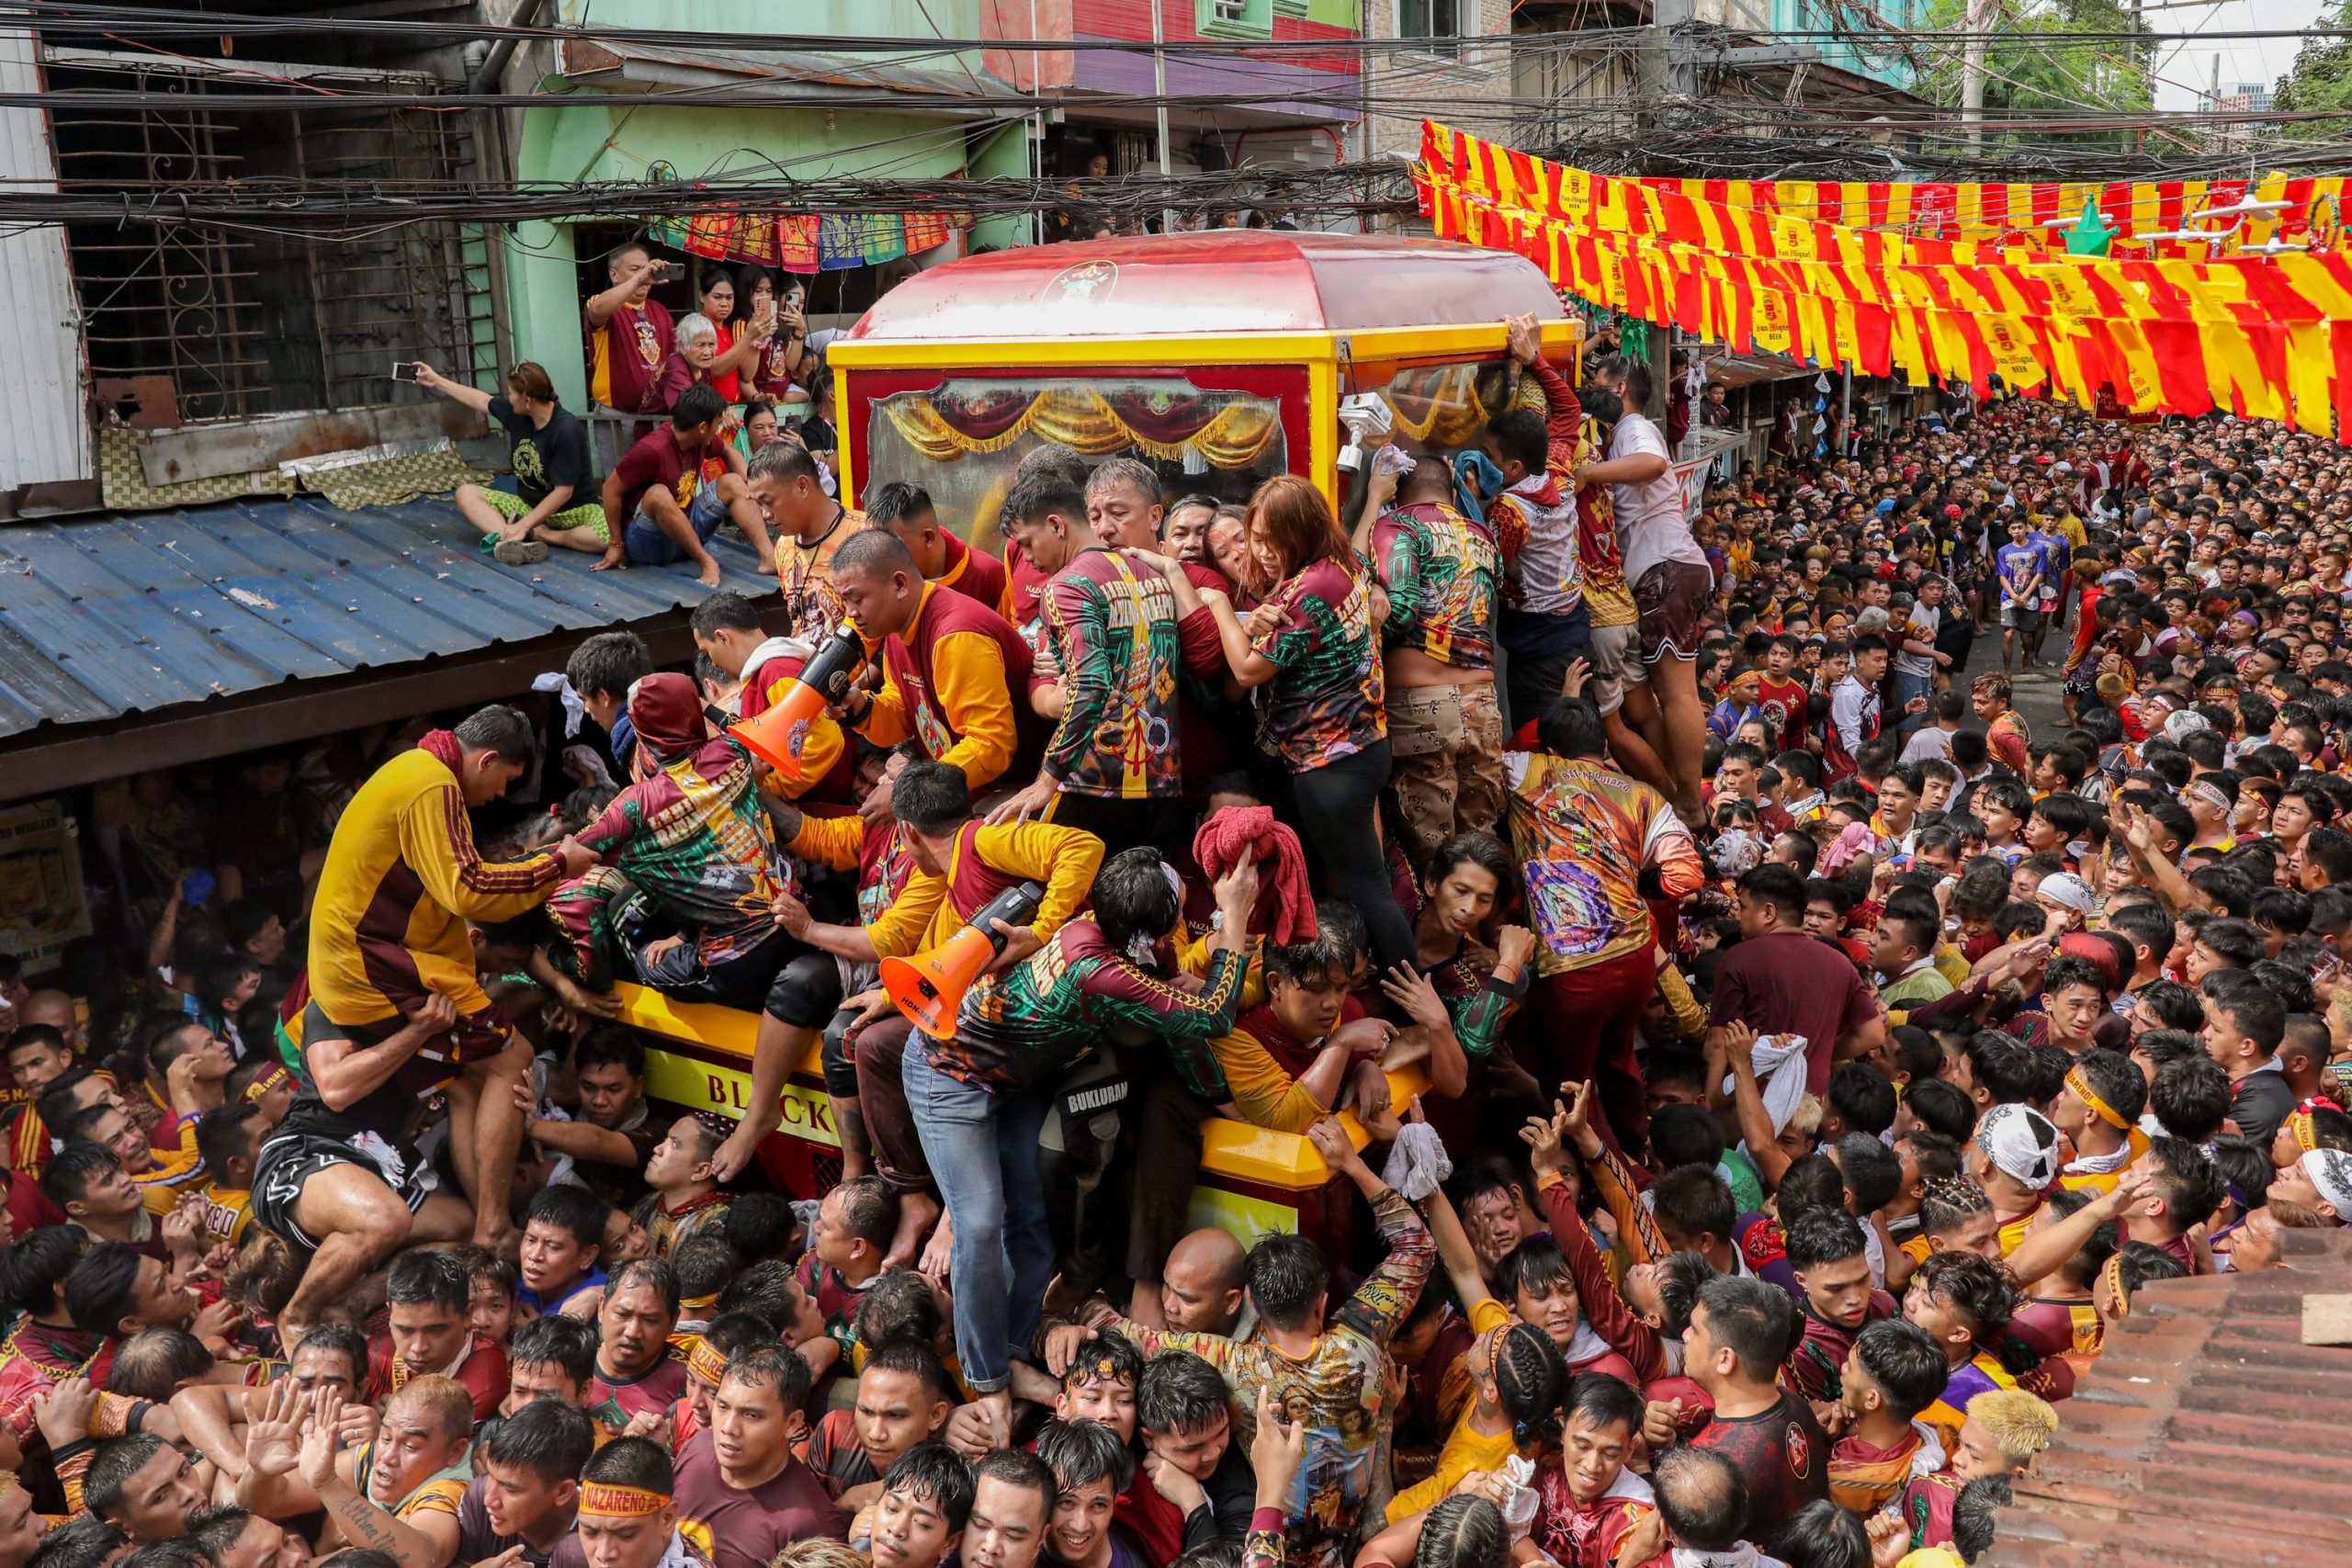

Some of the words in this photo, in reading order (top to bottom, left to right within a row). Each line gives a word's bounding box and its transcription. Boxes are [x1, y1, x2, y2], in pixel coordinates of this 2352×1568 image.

[1792, 249, 1811, 259] Miguel
[1770, 322, 1790, 333] Migue
[2135, 389, 2151, 400] BEER
[707, 1074, 833, 1134] BLCK
[1068, 1081, 1128, 1113] BUKLURAN
[585, 1485, 649, 1513] NAZARENO
